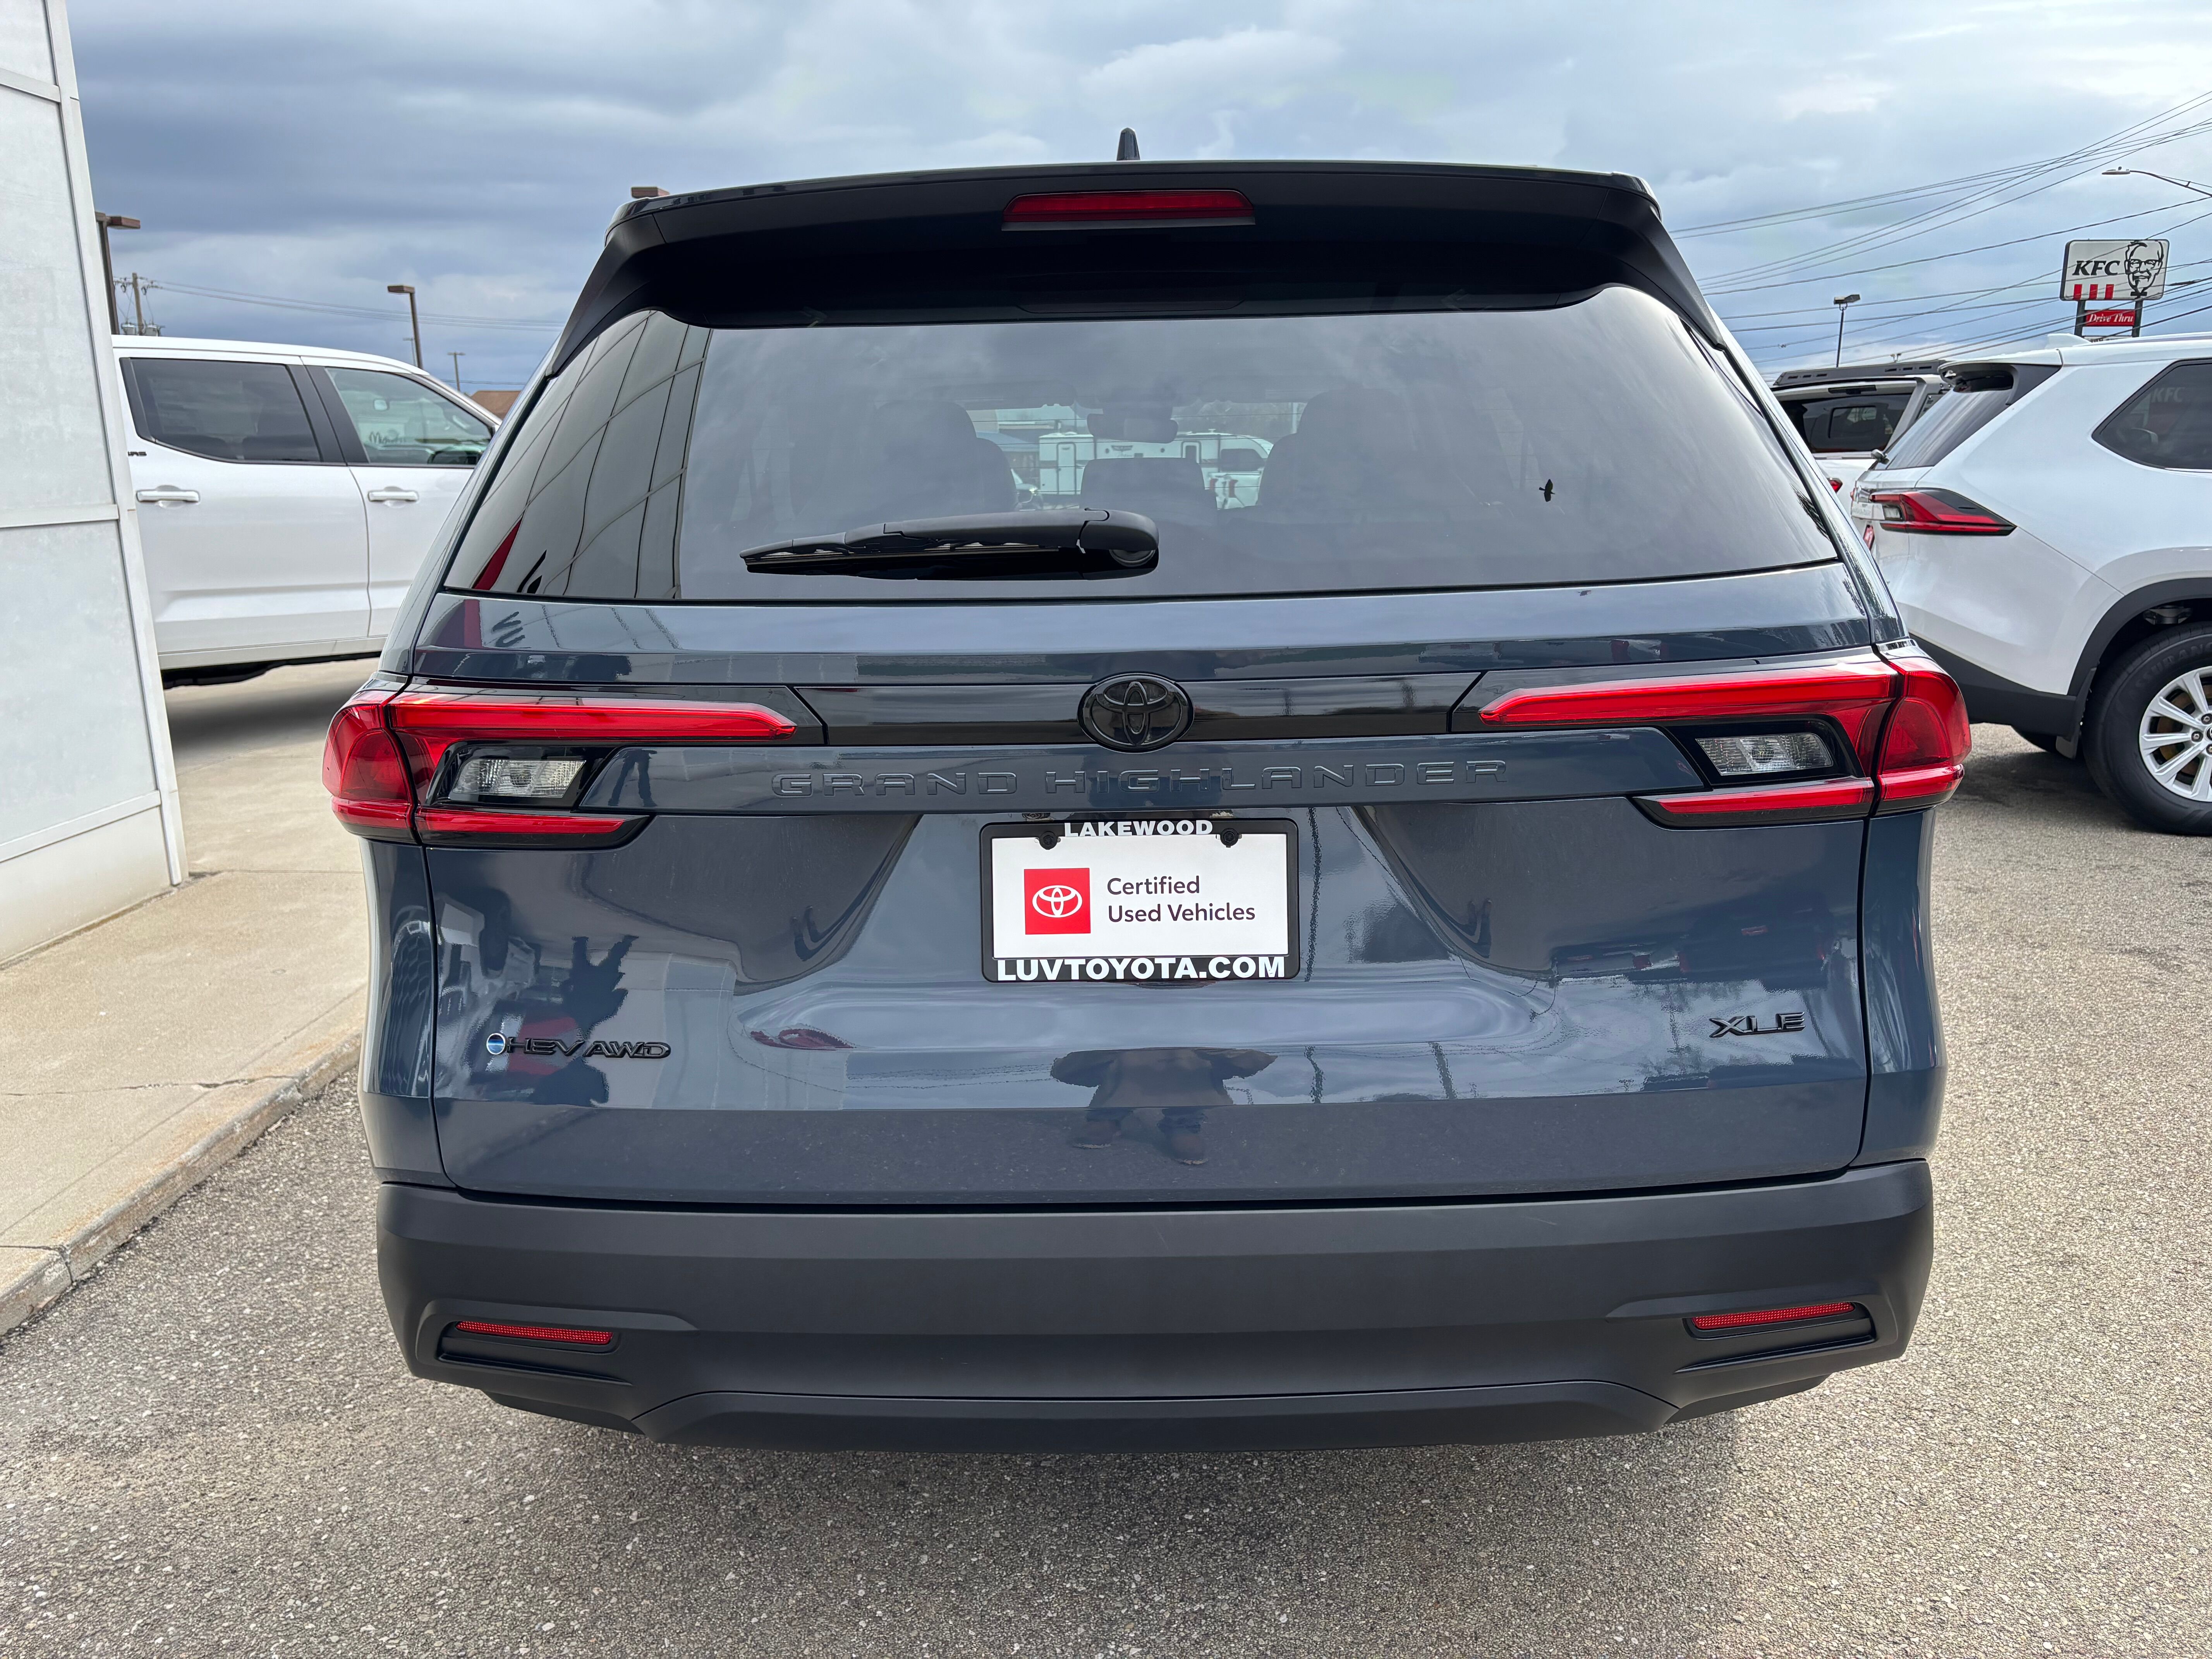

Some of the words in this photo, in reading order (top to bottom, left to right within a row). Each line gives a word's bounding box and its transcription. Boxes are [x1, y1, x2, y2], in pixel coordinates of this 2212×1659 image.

[2072, 260, 2120, 276] KFC
[2089, 314, 2111, 323] Drive
[2114, 314, 2133, 323] Thru
[2152, 387, 2185, 402] KFC
[772, 772, 1017, 796] GRAND
[1046, 760, 1507, 794] HIGHLANDER
[1064, 820, 1213, 838] LAKEWOOD
[1107, 876, 1200, 895] Certified
[1108, 904, 1161, 922] Used
[1168, 903, 1255, 921] Vehicles
[997, 957, 1285, 981] LUVTOYOTA.COM
[1709, 1012, 1806, 1038] XLE
